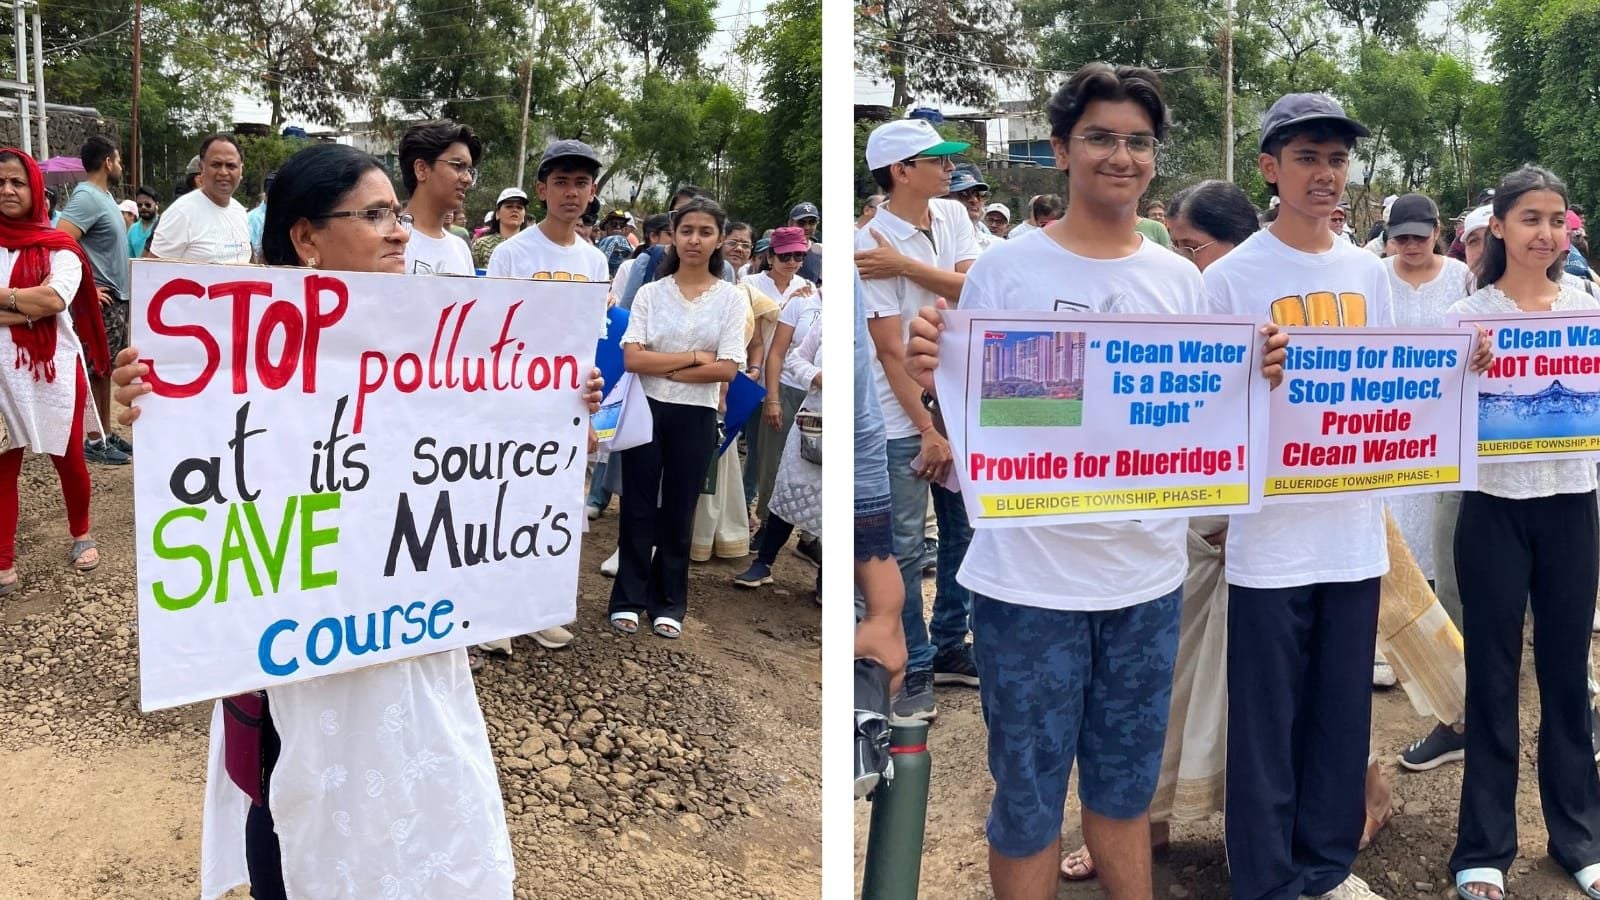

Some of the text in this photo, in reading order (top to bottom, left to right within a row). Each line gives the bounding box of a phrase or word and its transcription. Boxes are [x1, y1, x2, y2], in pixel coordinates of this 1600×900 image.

[1106, 340, 1173, 363] Clean
[1179, 340, 1246, 363] Water
[1498, 328, 1562, 350] Clean
[138, 274, 580, 434] STOP pollution
[1283, 345, 1457, 372] Rising for Rivers
[1488, 356, 1530, 379] NOT
[1113, 371, 1222, 394] is a Basic
[1288, 376, 1442, 405] Stop Neglect,
[1129, 402, 1190, 427] Right
[1321, 409, 1412, 436] Provide
[169, 401, 267, 503] at
[309, 395, 370, 493] its
[1282, 434, 1437, 467] Clean Water!
[1478, 441, 1533, 452] BLUERIDGE
[970, 453, 1068, 481] Provide
[1073, 452, 1110, 480] for
[1115, 446, 1232, 477] Blueridge
[1274, 479, 1339, 490] BLUERIDGE
[996, 496, 1080, 511] BLUERIDGE
[1084, 493, 1159, 508] TOWNSHIP,
[152, 481, 571, 611] SAVE Mula's
[257, 599, 471, 676] course.
